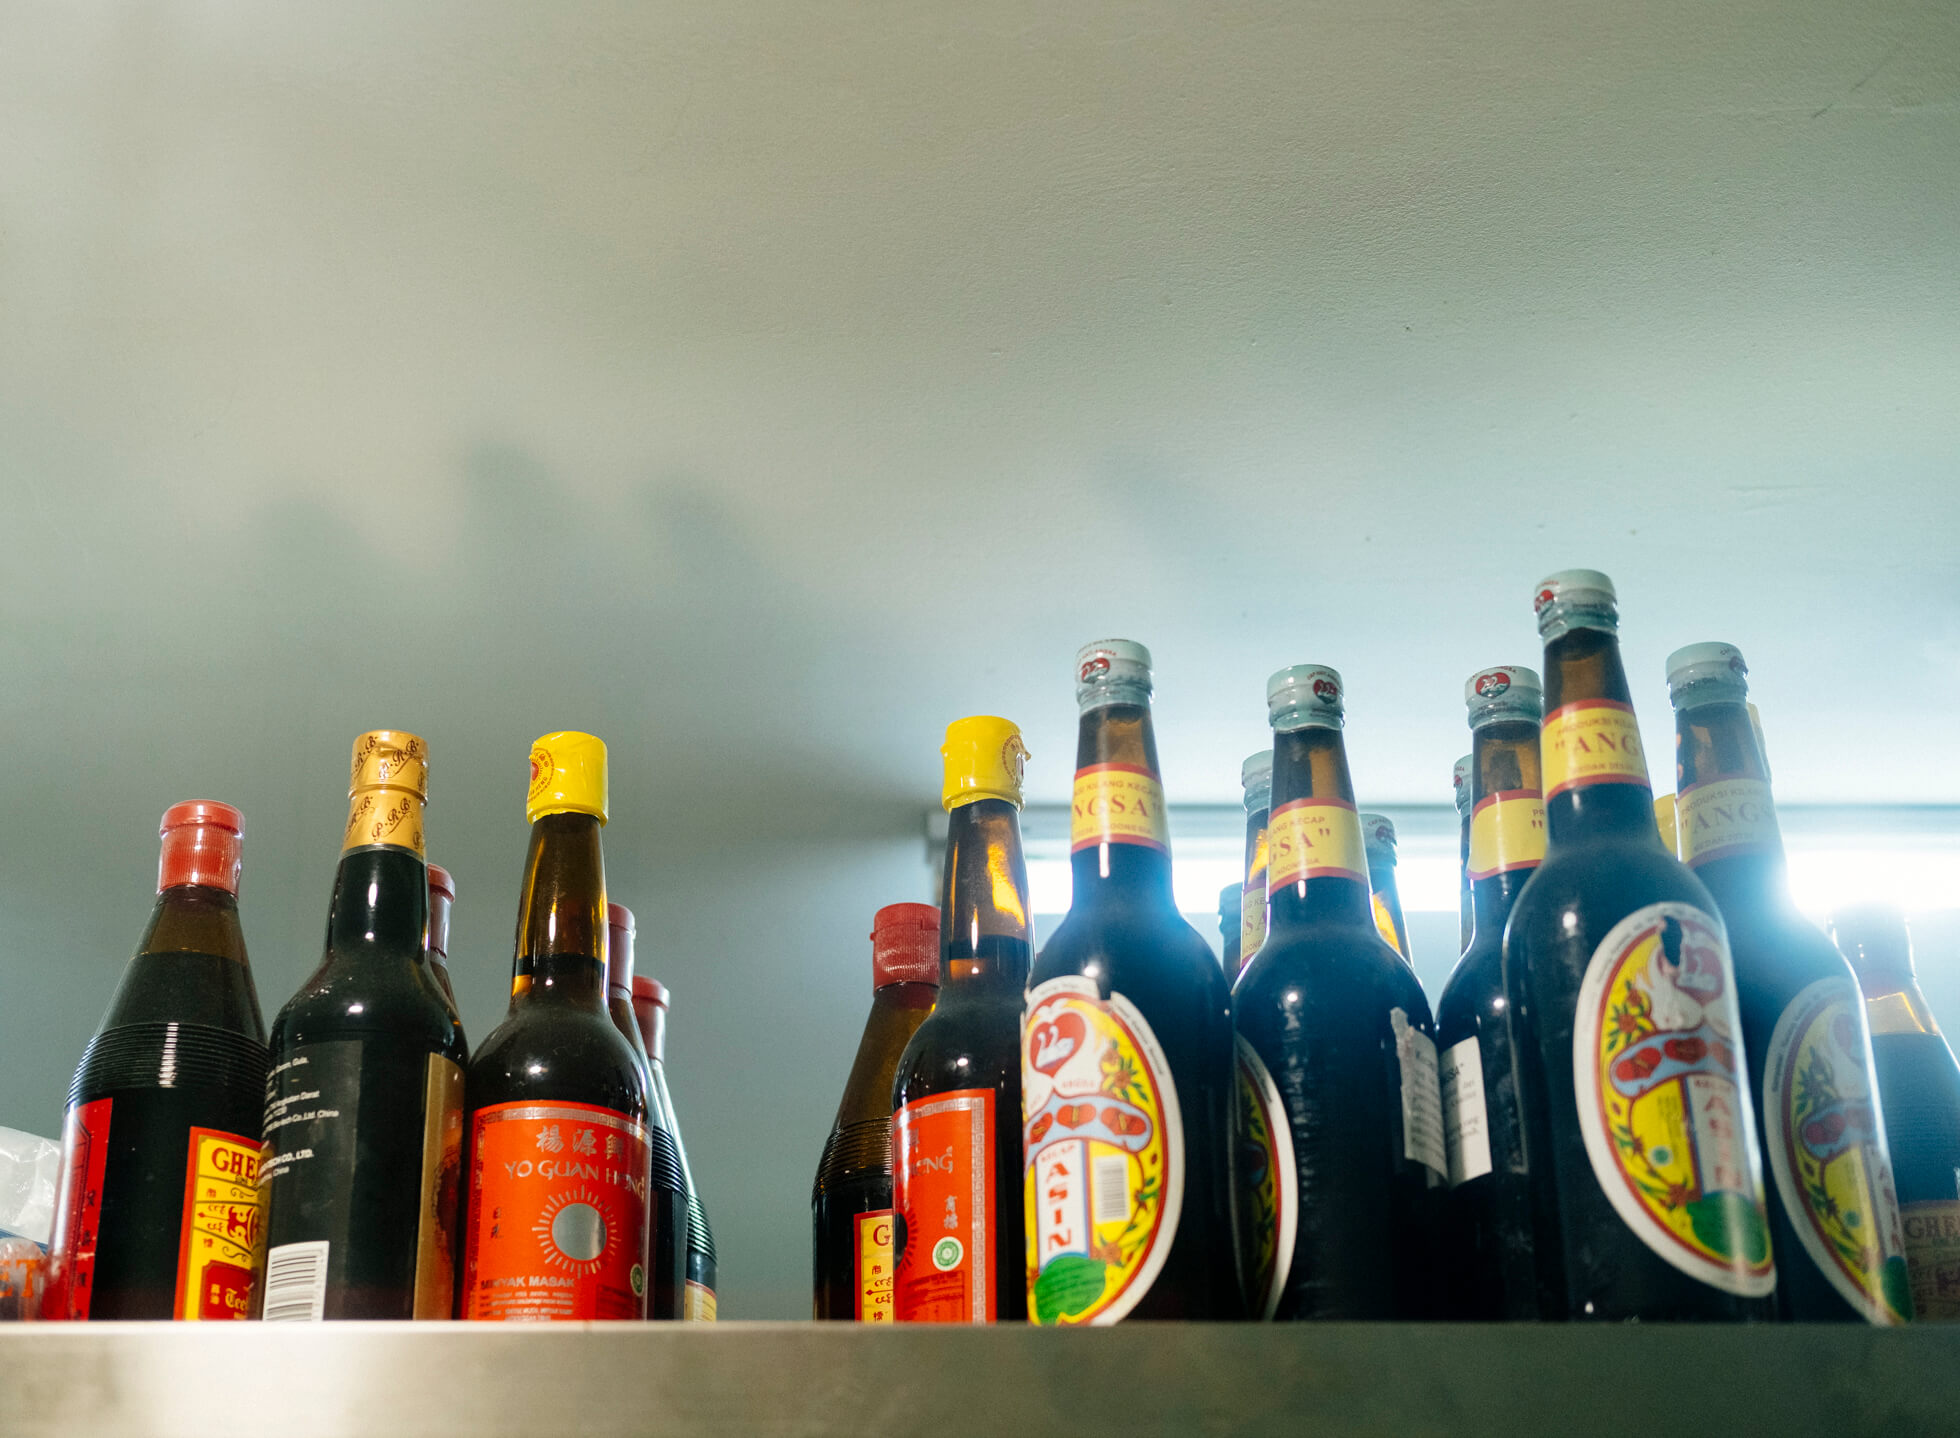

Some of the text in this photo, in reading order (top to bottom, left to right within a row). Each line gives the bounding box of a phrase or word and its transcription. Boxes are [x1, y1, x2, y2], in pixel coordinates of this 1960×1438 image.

[504, 1160, 534, 1180] YO
[537, 1159, 599, 1180] GUAN
[1046, 1161, 1073, 1252] ASIN
